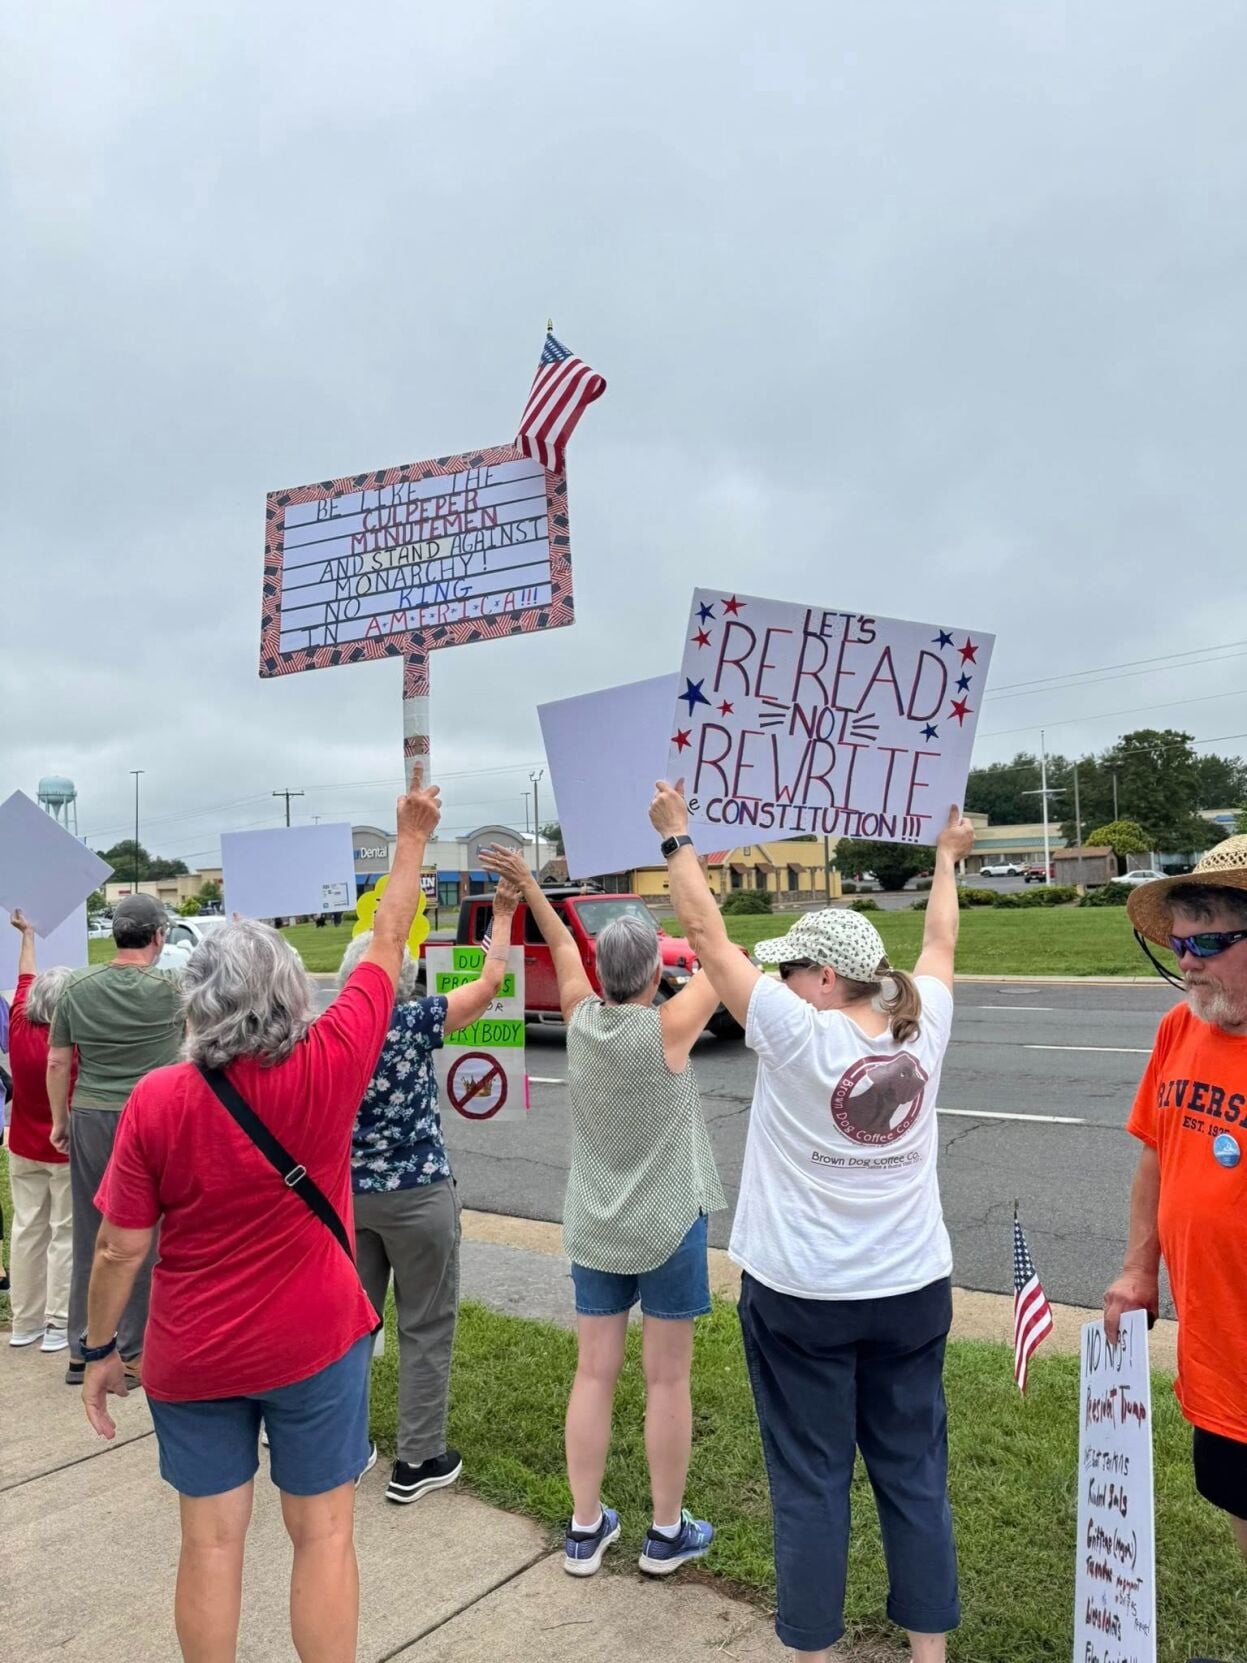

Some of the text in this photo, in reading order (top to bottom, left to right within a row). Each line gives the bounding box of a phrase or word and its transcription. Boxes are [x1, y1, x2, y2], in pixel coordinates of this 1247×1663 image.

[317, 467, 494, 521] BE LIKE THE
[363, 490, 479, 532] CULPEPER
[320, 517, 540, 583] AND STAND AGAINST
[351, 507, 498, 554] MINUTEMEN
[325, 579, 473, 624] NO KING
[301, 624, 339, 647] IN
[803, 609, 876, 644] LET'S
[714, 620, 948, 721] REREAD
[789, 702, 858, 744] NOT
[693, 722, 942, 819] REWRITE
[706, 797, 921, 843] CONSTITUTION!!!
[360, 847, 388, 858] Dental
[459, 954, 486, 969] DU
[834, 1078, 854, 1110] Brown
[1158, 1079, 1247, 1129] RIVERS
[836, 1112, 855, 1134] Dog
[856, 1130, 894, 1143] Coffee
[1182, 1115, 1205, 1133] EST.
[811, 1151, 845, 1165] Brown
[848, 1157, 871, 1167] Dog
[873, 1156, 904, 1166] Coffee
[1086, 1328, 1101, 1377] NO
